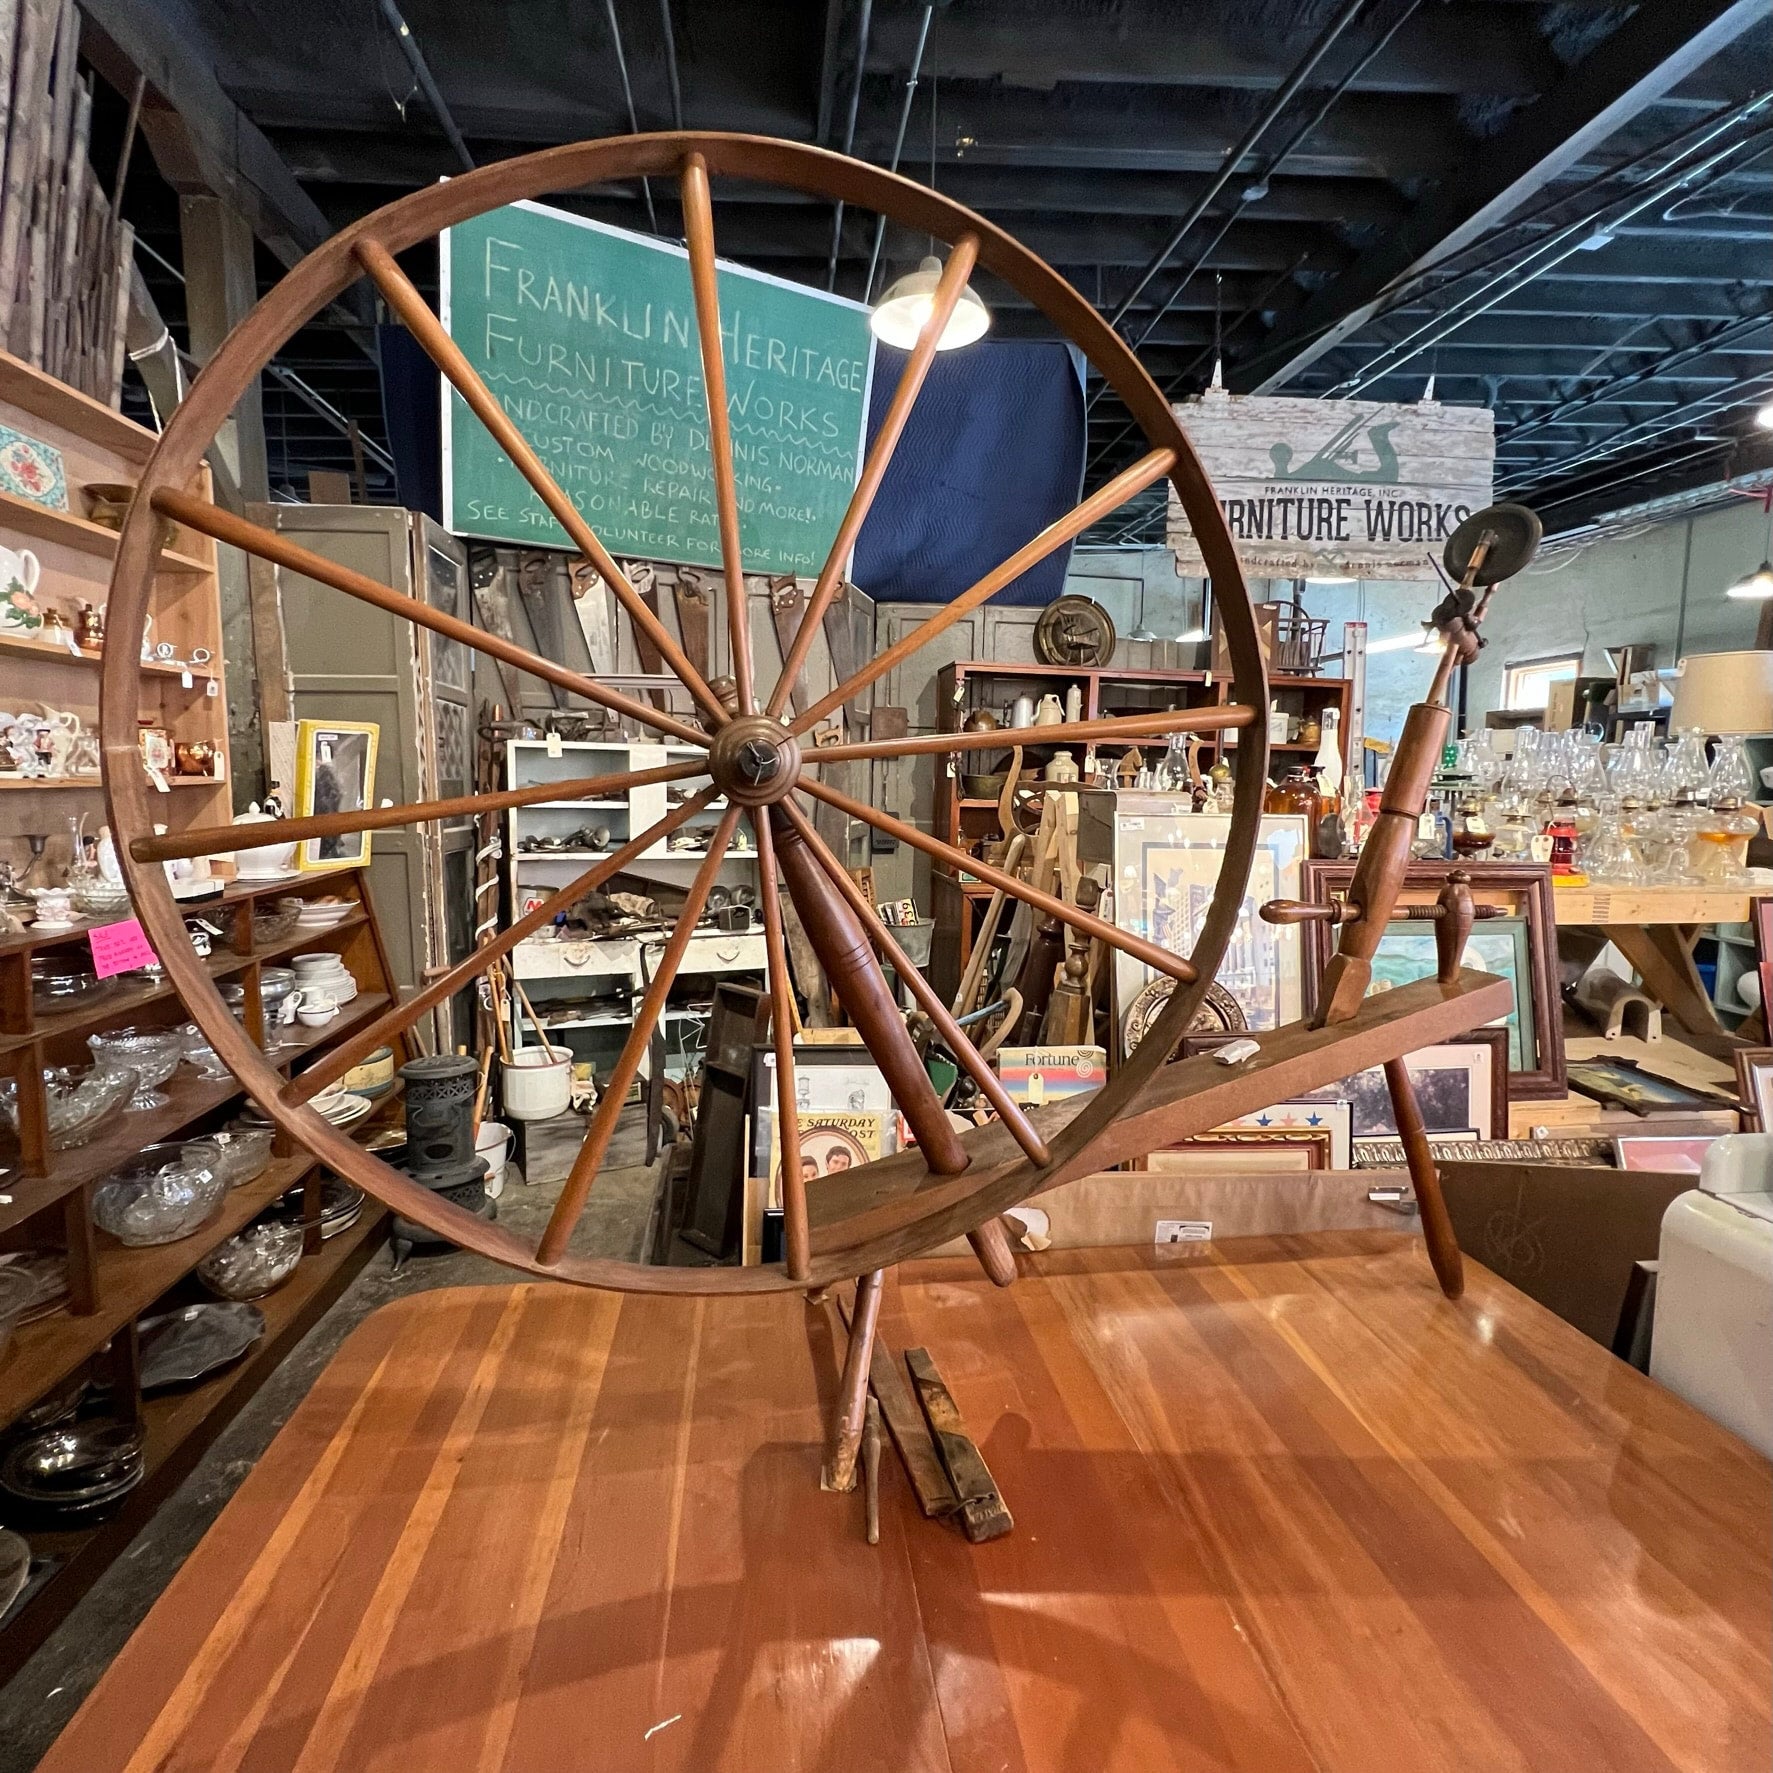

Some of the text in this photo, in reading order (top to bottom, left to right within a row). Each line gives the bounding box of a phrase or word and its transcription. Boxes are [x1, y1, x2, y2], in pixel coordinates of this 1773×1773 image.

[485, 236, 691, 349] FRANKLIN
[485, 312, 839, 438] FURNITURE WORKS
[779, 451, 855, 484] NORMAN
[1264, 486, 1318, 497] FRANKLIN
[735, 498, 755, 514] ND
[467, 500, 510, 521] SEE
[686, 537, 721, 554] FOR
[741, 548, 771, 561] ORE
[779, 550, 816, 566] INFO!
[1024, 1053, 1080, 1067] Fortune
[806, 1118, 876, 1131] SATURDAY
[848, 1130, 876, 1139] OST
